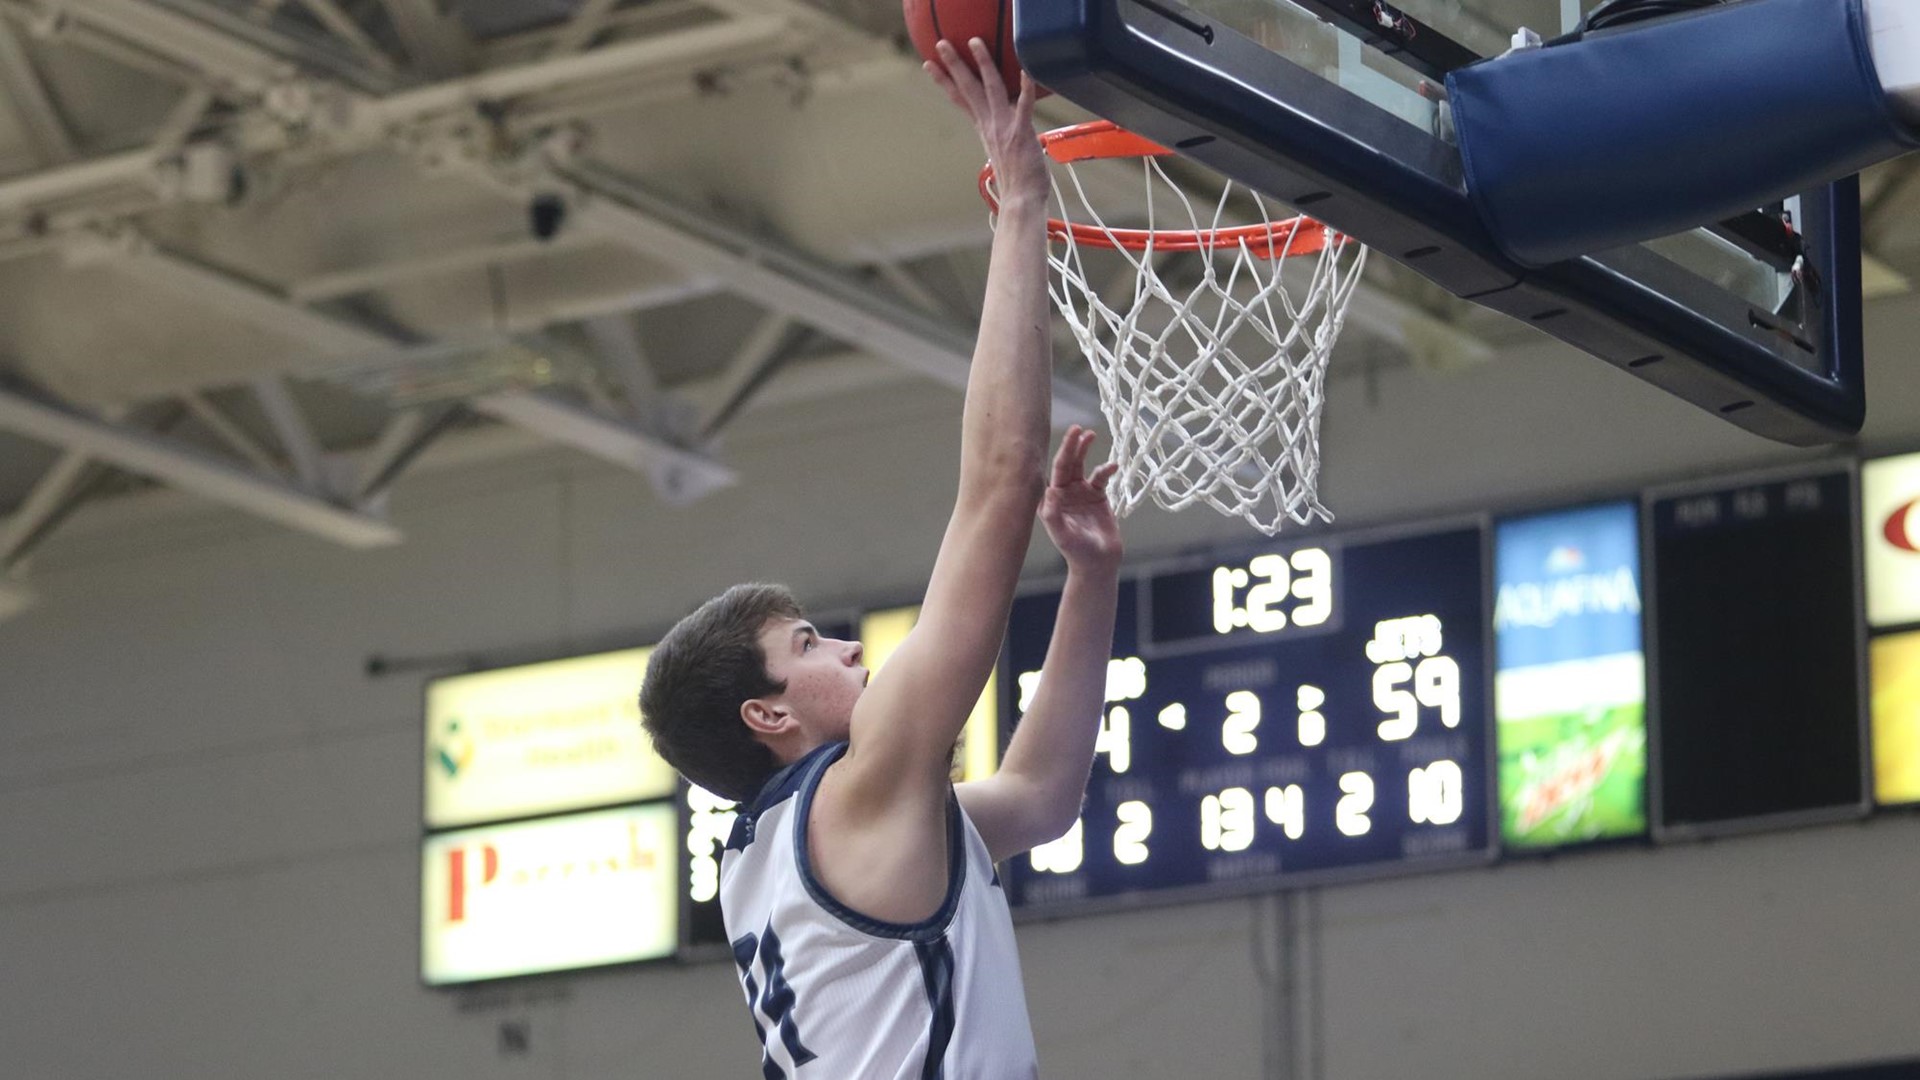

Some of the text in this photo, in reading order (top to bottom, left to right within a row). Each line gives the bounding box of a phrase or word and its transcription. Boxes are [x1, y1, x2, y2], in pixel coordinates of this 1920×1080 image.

[1212, 547, 1332, 634] 1:23
[1494, 565, 1641, 630] AQUAFINA
[1222, 690, 1261, 755] 2
[1372, 655, 1461, 742] 59
[1200, 787, 1255, 852] 13
[1264, 784, 1304, 840] 4
[1335, 771, 1375, 837] 2
[1408, 759, 1463, 825] 10
[1113, 800, 1152, 865] 2
